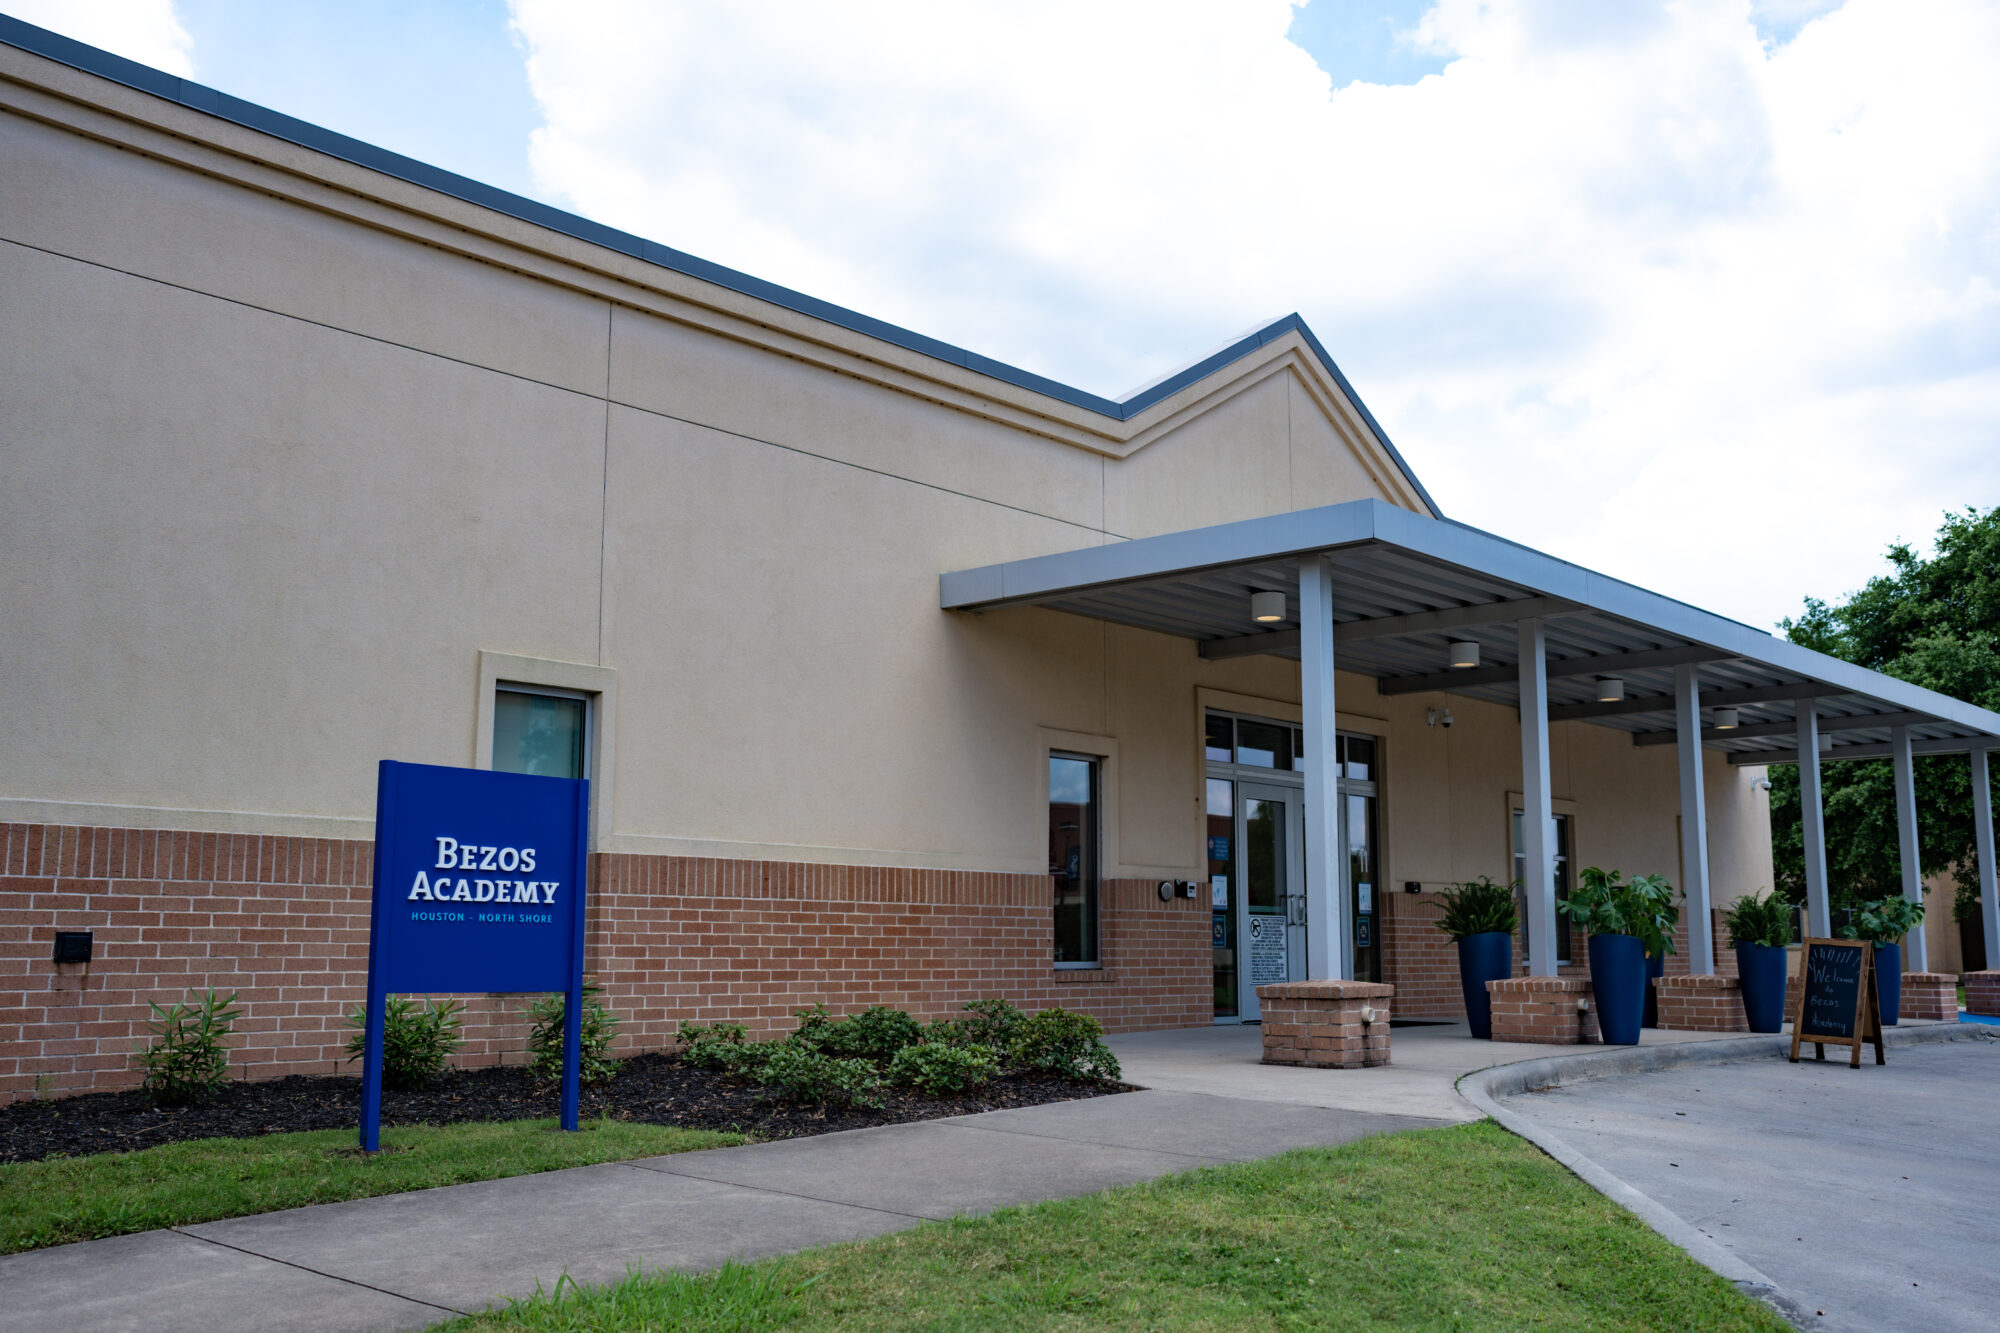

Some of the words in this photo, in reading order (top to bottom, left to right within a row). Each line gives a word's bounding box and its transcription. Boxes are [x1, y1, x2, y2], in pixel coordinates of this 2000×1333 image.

[435, 836, 536, 872] BEZOS
[408, 871, 560, 904] ACADEMY
[411, 912, 464, 921] HOUSTON
[479, 913, 514, 922] NORTH
[519, 914, 552, 923] SHORE
[1813, 965, 1855, 983] Welcome
